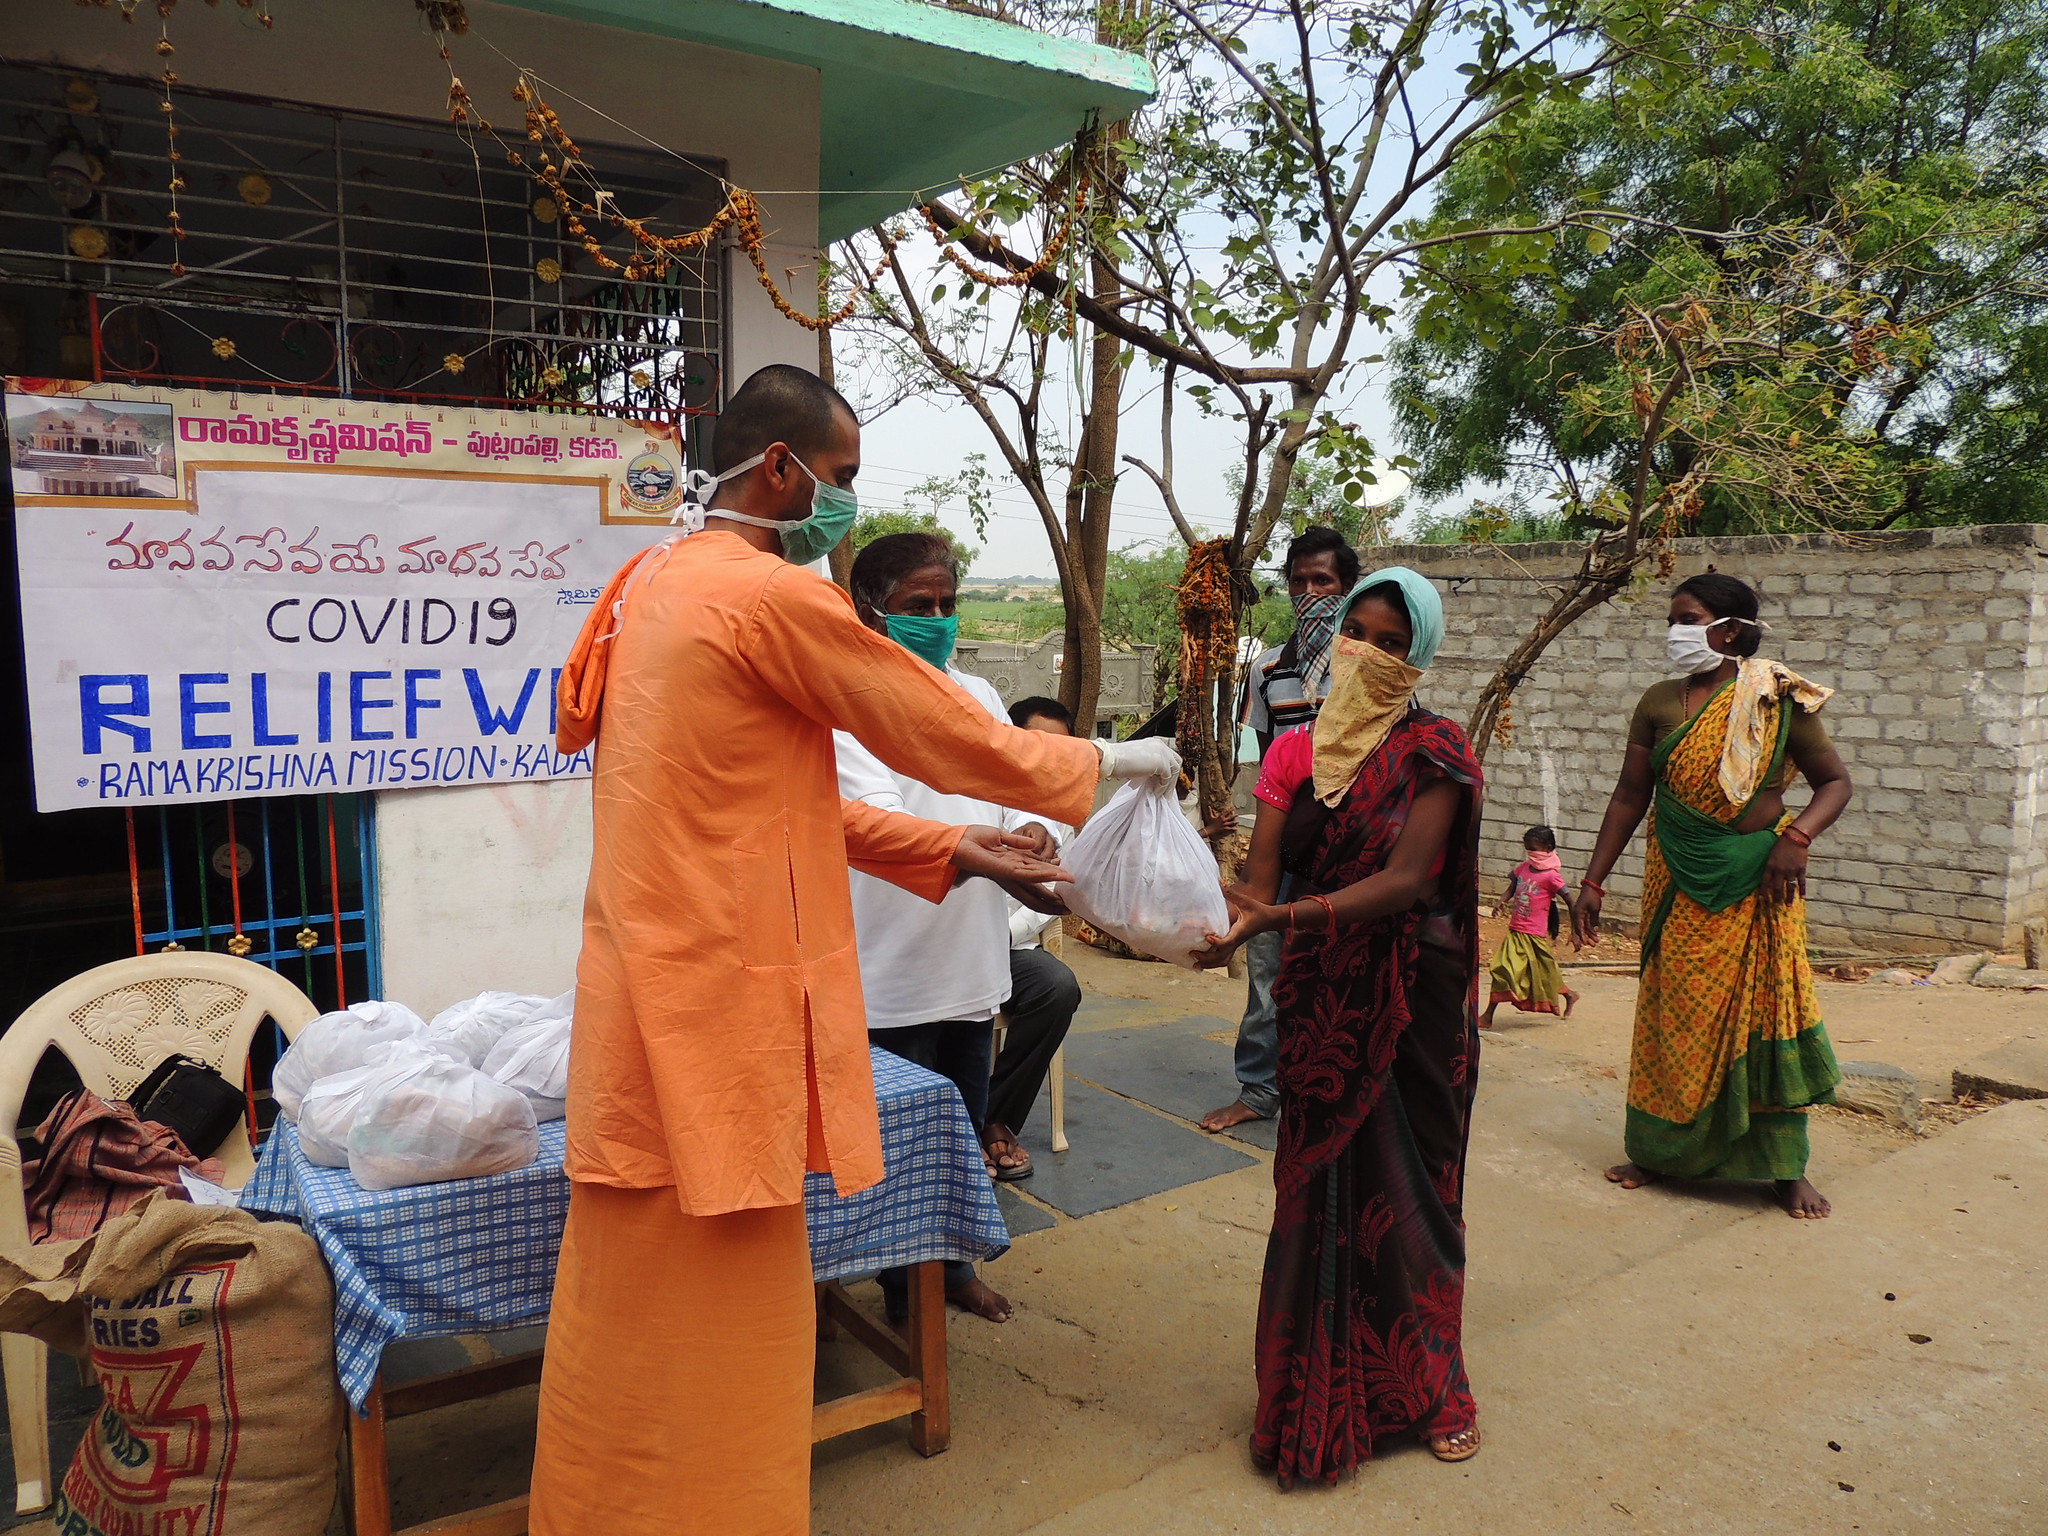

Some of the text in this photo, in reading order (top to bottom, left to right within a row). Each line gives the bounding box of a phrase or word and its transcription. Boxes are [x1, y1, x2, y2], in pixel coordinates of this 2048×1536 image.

[178, 413, 432, 464] రామకృష్ణమిషన్
[79, 668, 442, 755] RELIEF
[99, 752, 338, 799] RAMAKRISHNA
[347, 745, 498, 786] MISSION
